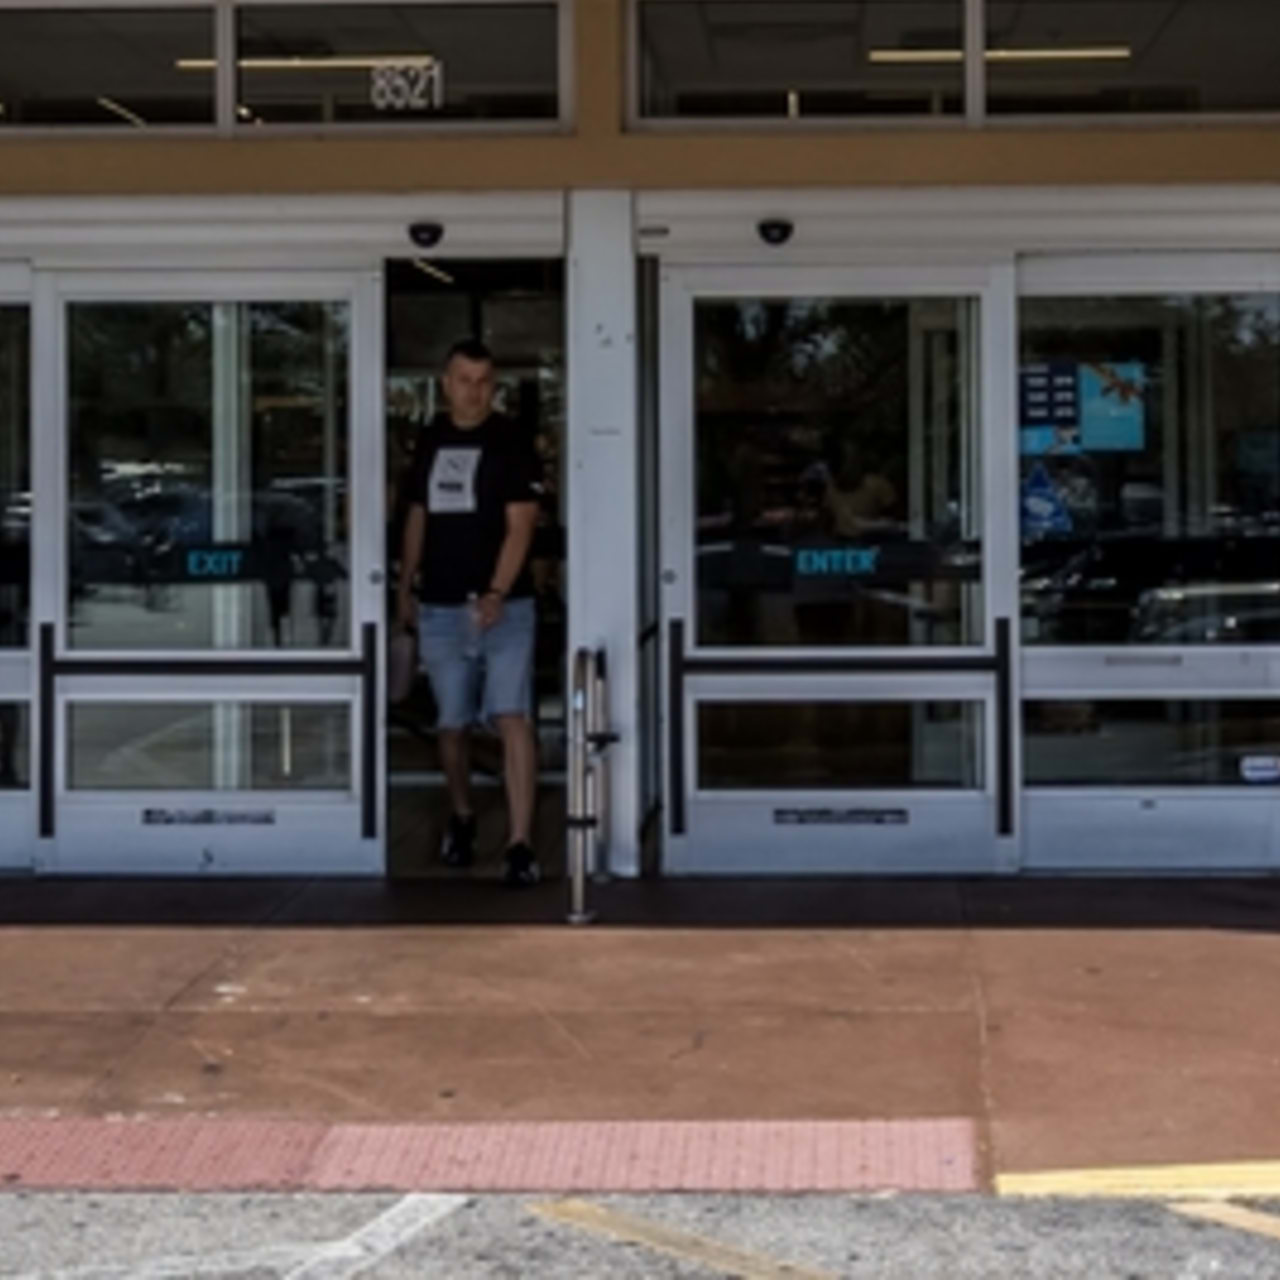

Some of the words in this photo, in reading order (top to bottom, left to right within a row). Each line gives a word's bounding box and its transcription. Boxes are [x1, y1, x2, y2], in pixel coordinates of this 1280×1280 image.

[370, 61, 443, 109] 8521
[187, 549, 243, 576] EXIT
[797, 548, 875, 574] ENTER
